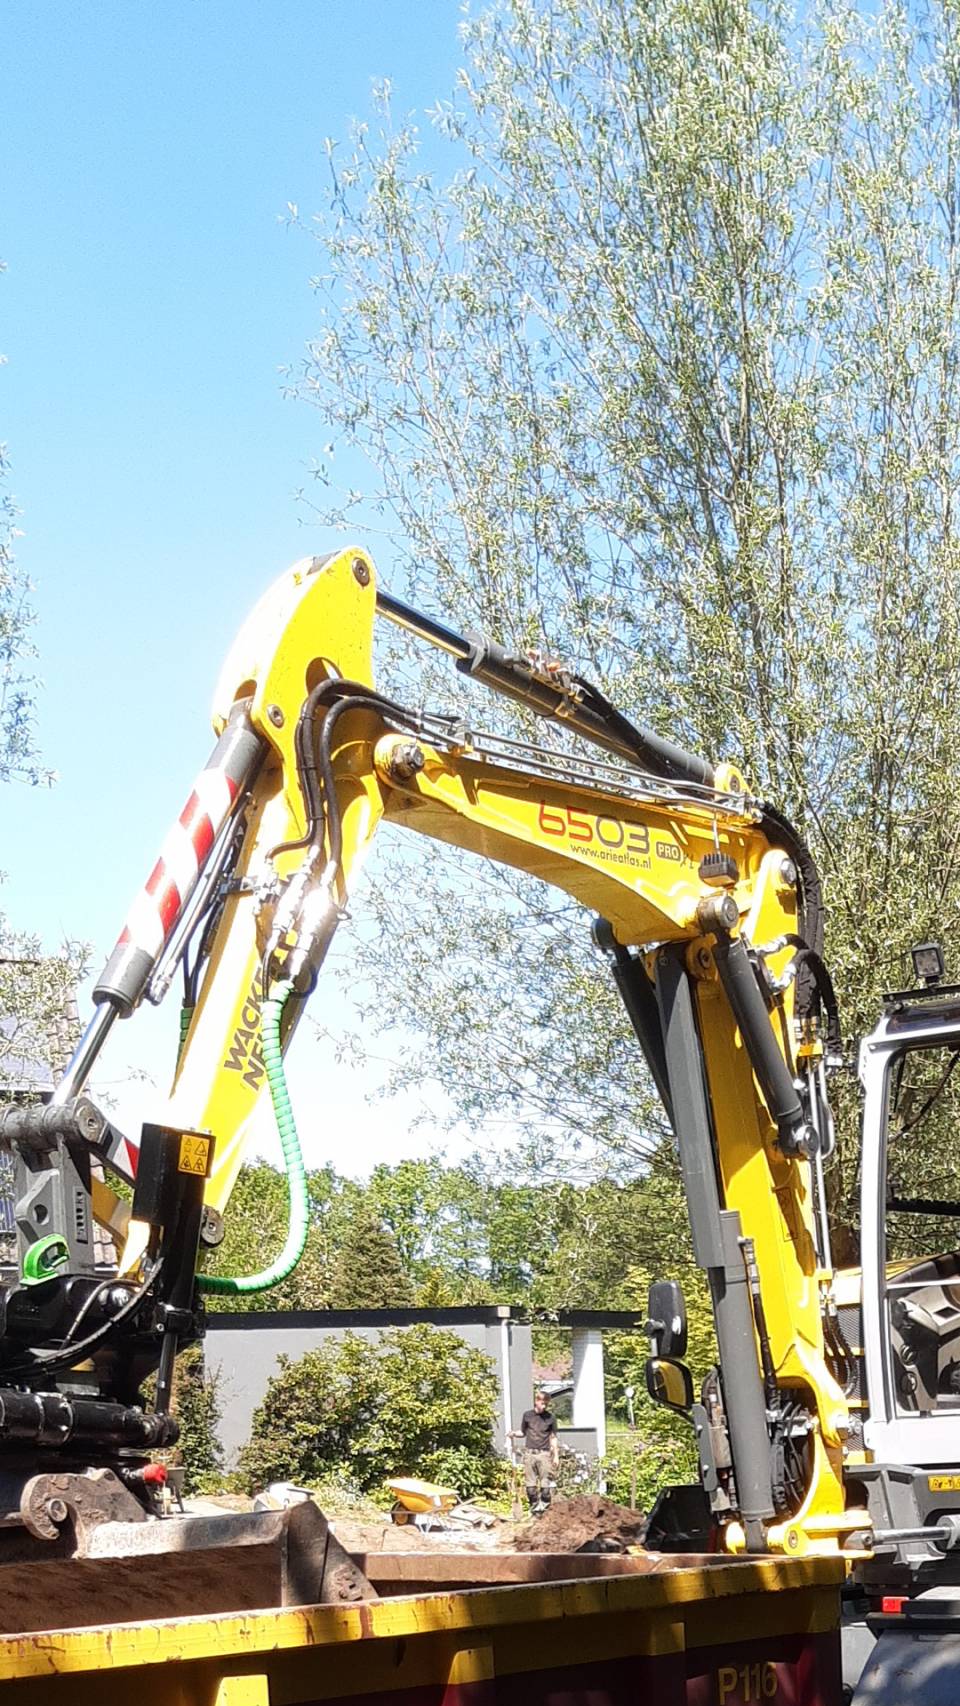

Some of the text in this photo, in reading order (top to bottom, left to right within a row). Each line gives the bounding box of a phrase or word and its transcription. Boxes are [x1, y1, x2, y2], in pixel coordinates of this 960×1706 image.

[538, 801, 650, 855] 6503
[657, 842, 680, 861] PRO
[717, 1661, 779, 1706] P116
